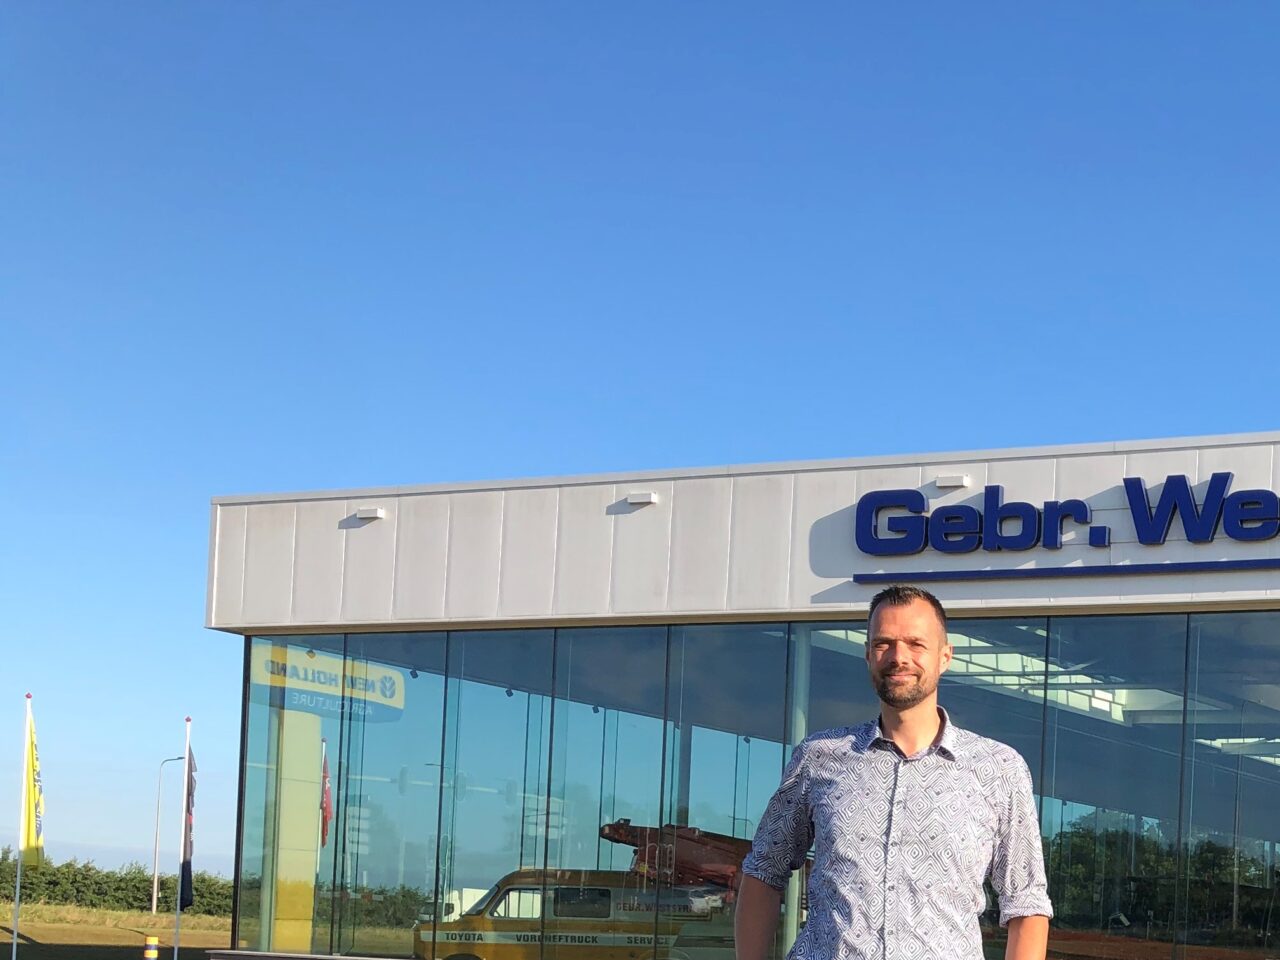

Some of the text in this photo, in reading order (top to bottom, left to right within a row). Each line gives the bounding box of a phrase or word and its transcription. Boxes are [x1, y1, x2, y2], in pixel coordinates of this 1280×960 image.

[855, 484, 1111, 557] Gebr.
[445, 932, 484, 942] TOYOTA
[626, 936, 672, 945] SERVCE
